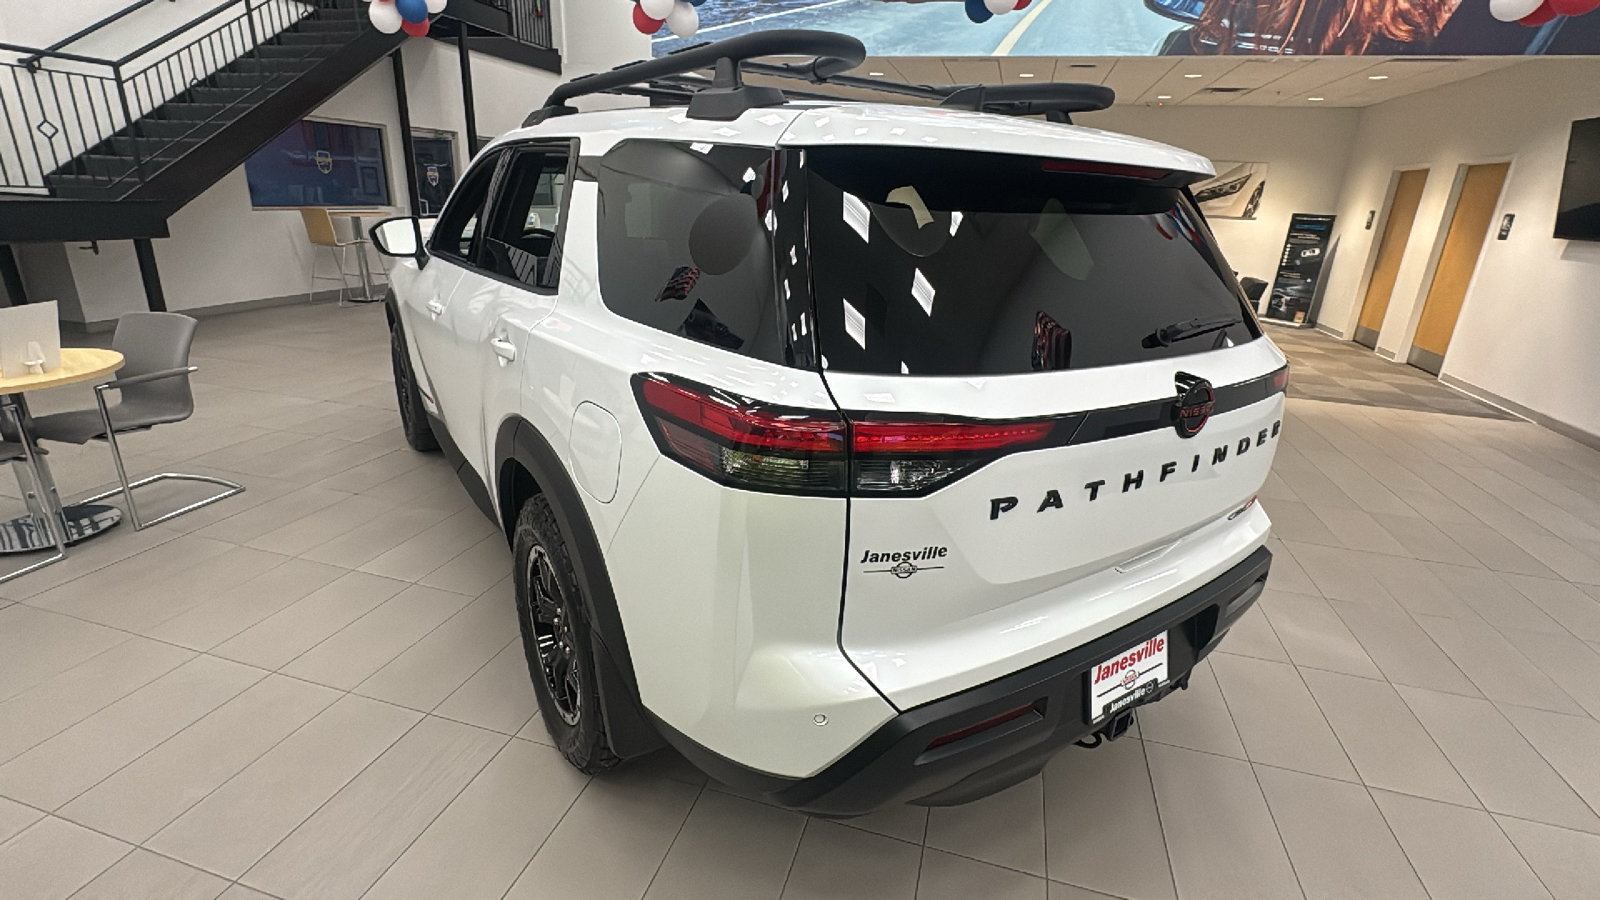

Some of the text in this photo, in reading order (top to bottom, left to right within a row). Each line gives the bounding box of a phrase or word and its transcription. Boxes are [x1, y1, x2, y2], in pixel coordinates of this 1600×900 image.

[989, 420, 1280, 520] PATHFINDER
[860, 546, 948, 563] Janesville
[1094, 638, 1164, 684] Janesville
[1110, 687, 1146, 713] Janesville
